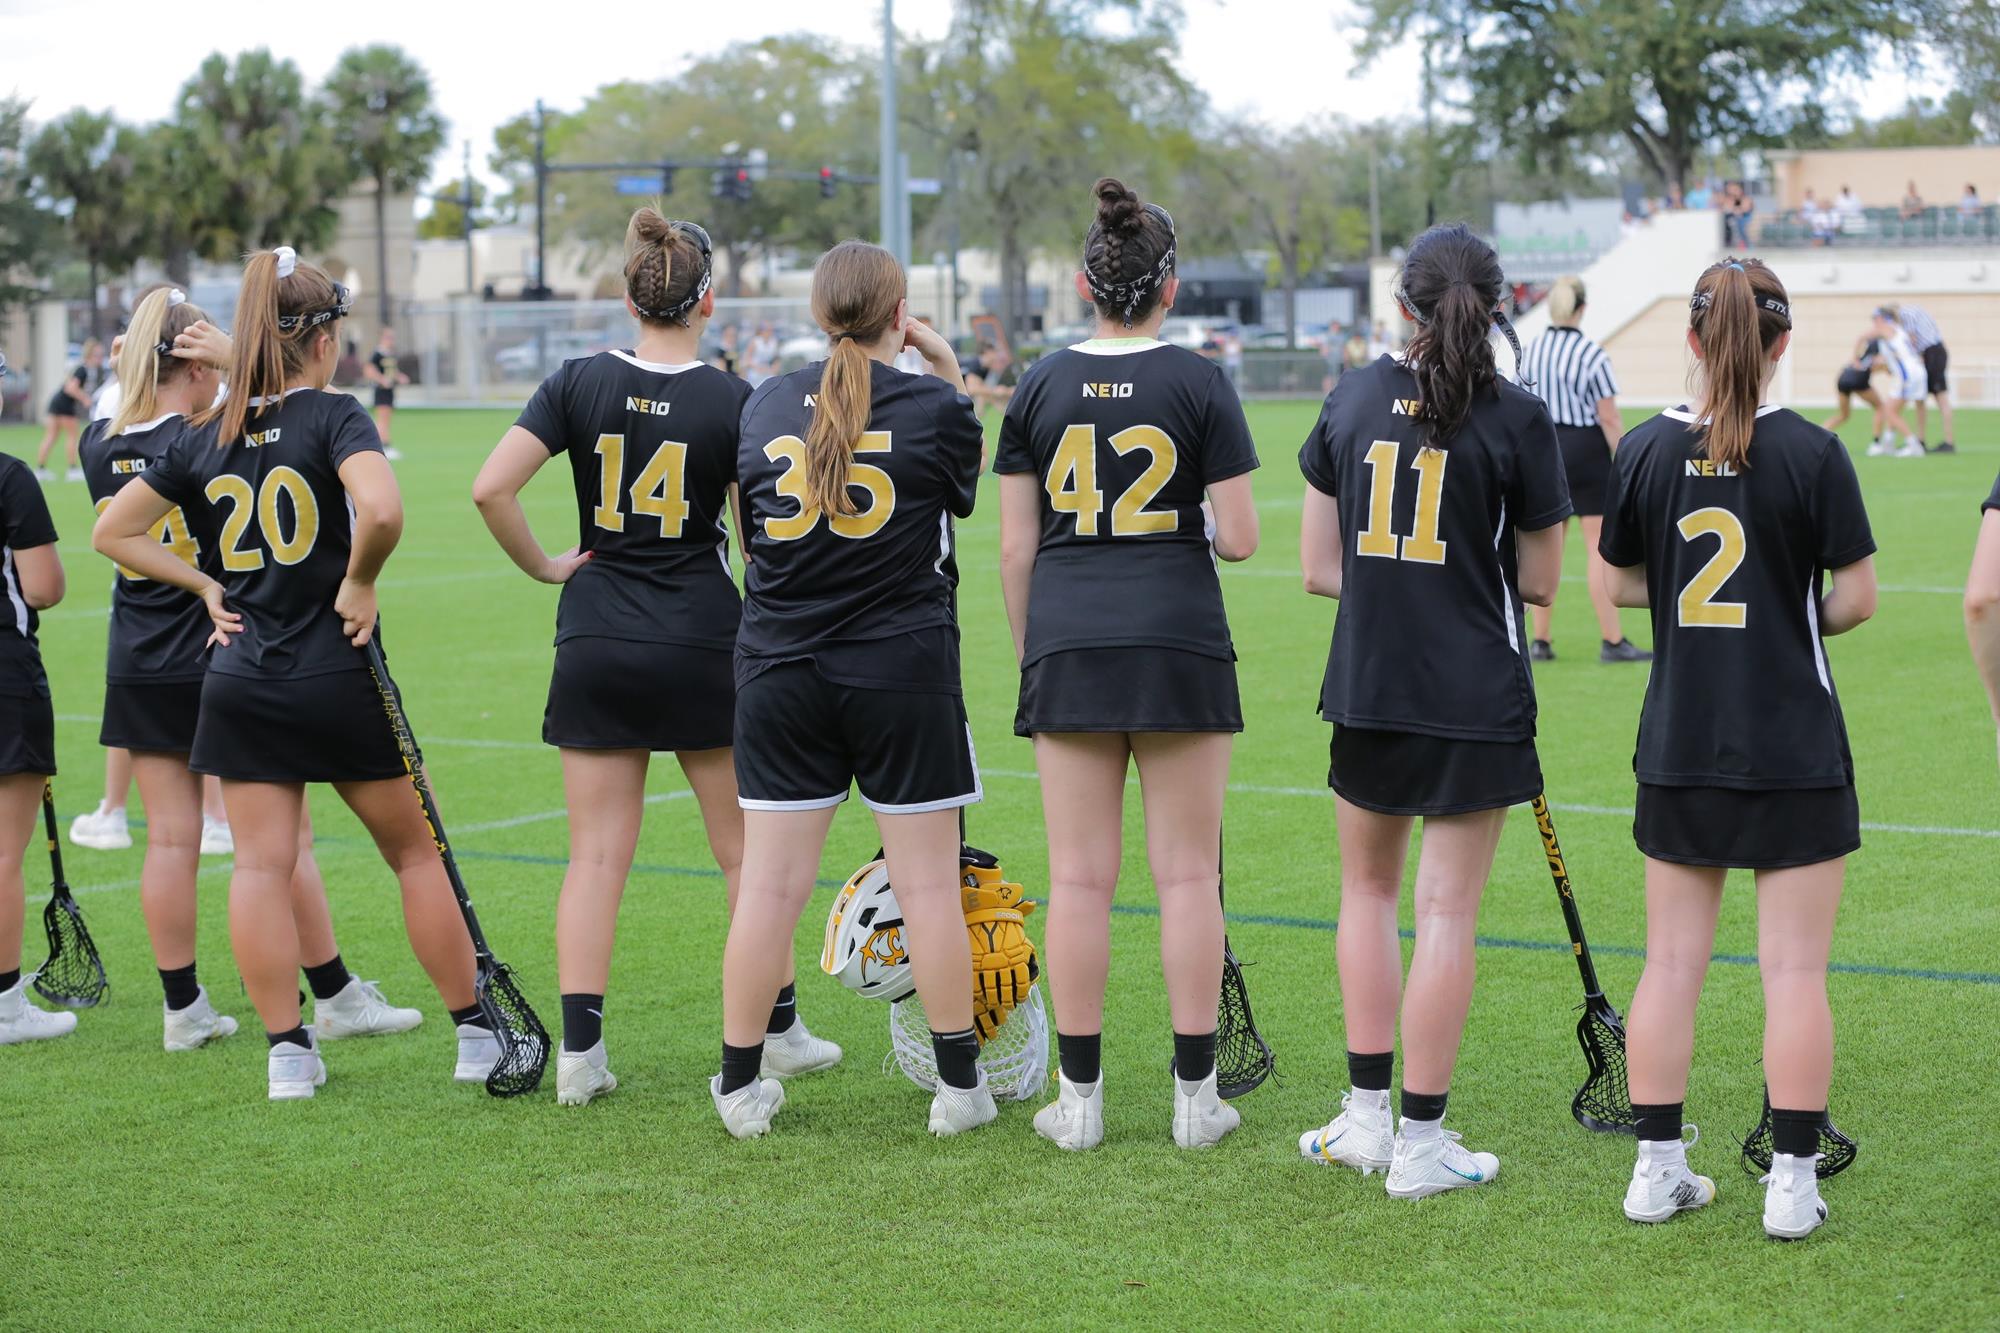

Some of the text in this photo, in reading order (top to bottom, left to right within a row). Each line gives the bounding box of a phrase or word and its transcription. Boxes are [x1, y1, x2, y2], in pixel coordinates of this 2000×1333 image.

[1158, 246, 1174, 271] STX
[1154, 264, 1172, 288] STX
[1764, 299, 1788, 316] STX
[1082, 383, 1134, 398] NE10
[626, 396, 671, 416] NE10
[1391, 398, 1424, 418] NE
[245, 428, 281, 448] NE10
[112, 458, 147, 475] NE10
[594, 433, 690, 539] 14
[762, 431, 896, 541] 35
[1045, 424, 1179, 537] 42
[1356, 440, 1449, 566] 11
[204, 465, 320, 572] 20
[1677, 507, 1748, 629] 2
